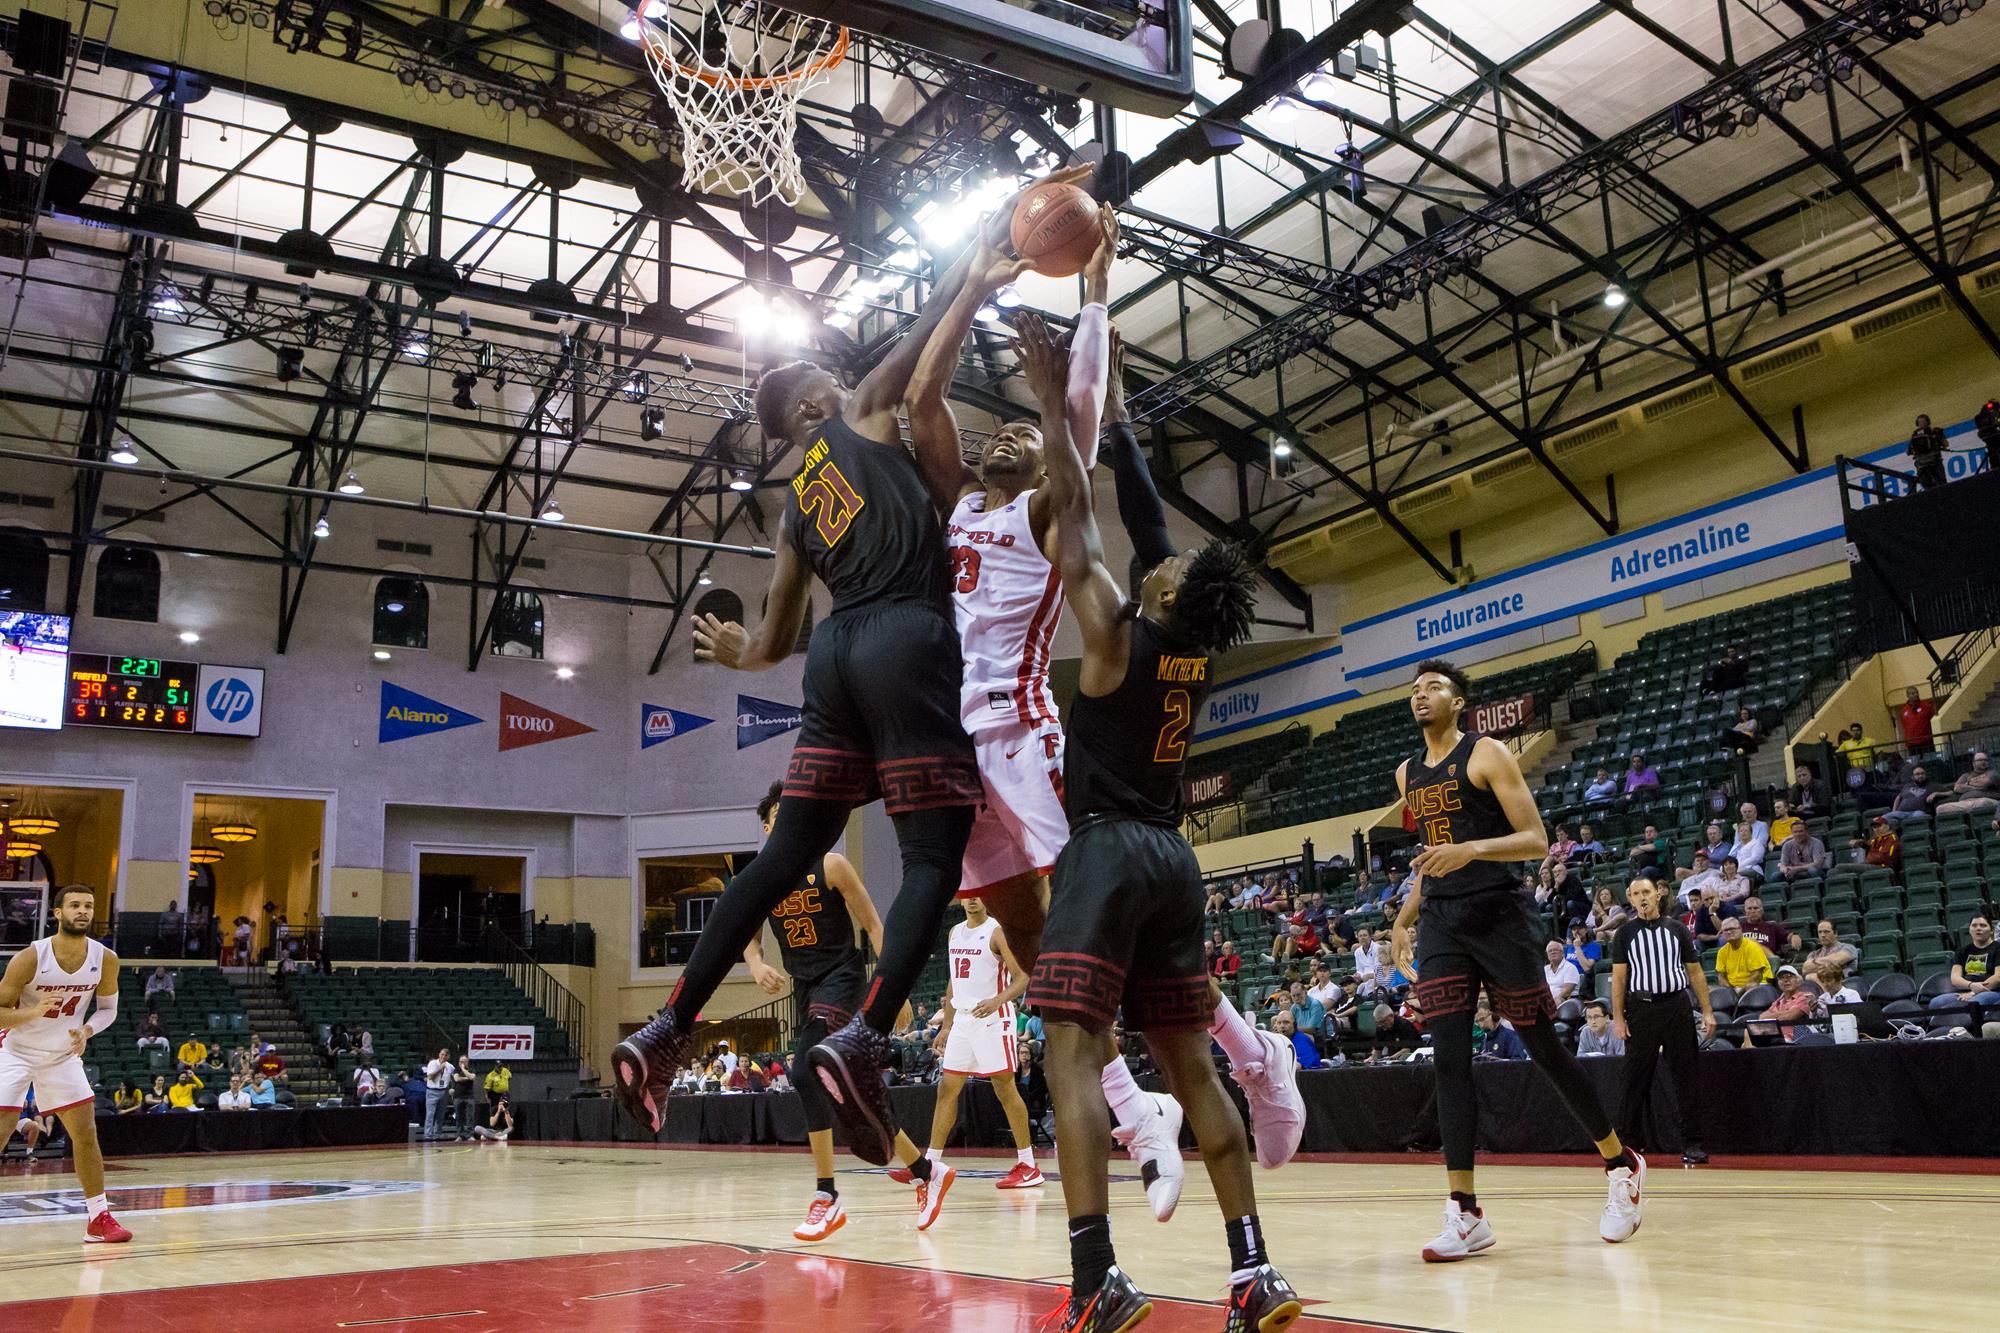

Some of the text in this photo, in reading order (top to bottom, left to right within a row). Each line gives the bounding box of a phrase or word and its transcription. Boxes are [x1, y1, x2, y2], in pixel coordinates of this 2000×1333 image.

[792, 437, 830, 496] OKGWU
[800, 461, 865, 548] 21
[1611, 522, 1751, 582] Adrenaline
[1417, 593, 1525, 642] Endurance
[121, 657, 159, 675] 2:27
[1157, 655, 1208, 681] MATHEWS
[80, 681, 102, 699] 39
[127, 686, 137, 700] 2
[167, 688, 189, 705] 51
[211, 678, 250, 723] hp
[76, 703, 87, 718] 5
[100, 706, 106, 718] 1
[154, 709, 164, 722] 2
[176, 710, 187, 724] 6
[387, 706, 449, 724] Alamo
[1209, 693, 1260, 723] Agility
[1476, 699, 1524, 734] GUEST
[506, 714, 554, 732] TORO
[651, 715, 669, 728] M
[737, 713, 802, 728] Champi
[1153, 689, 1190, 762] 2
[1192, 776, 1224, 803] HOME
[1408, 780, 1462, 820] USC
[1424, 817, 1453, 846] 15
[784, 917, 817, 948] 23
[955, 957, 971, 978] 12
[471, 1034, 532, 1050] ESPN
